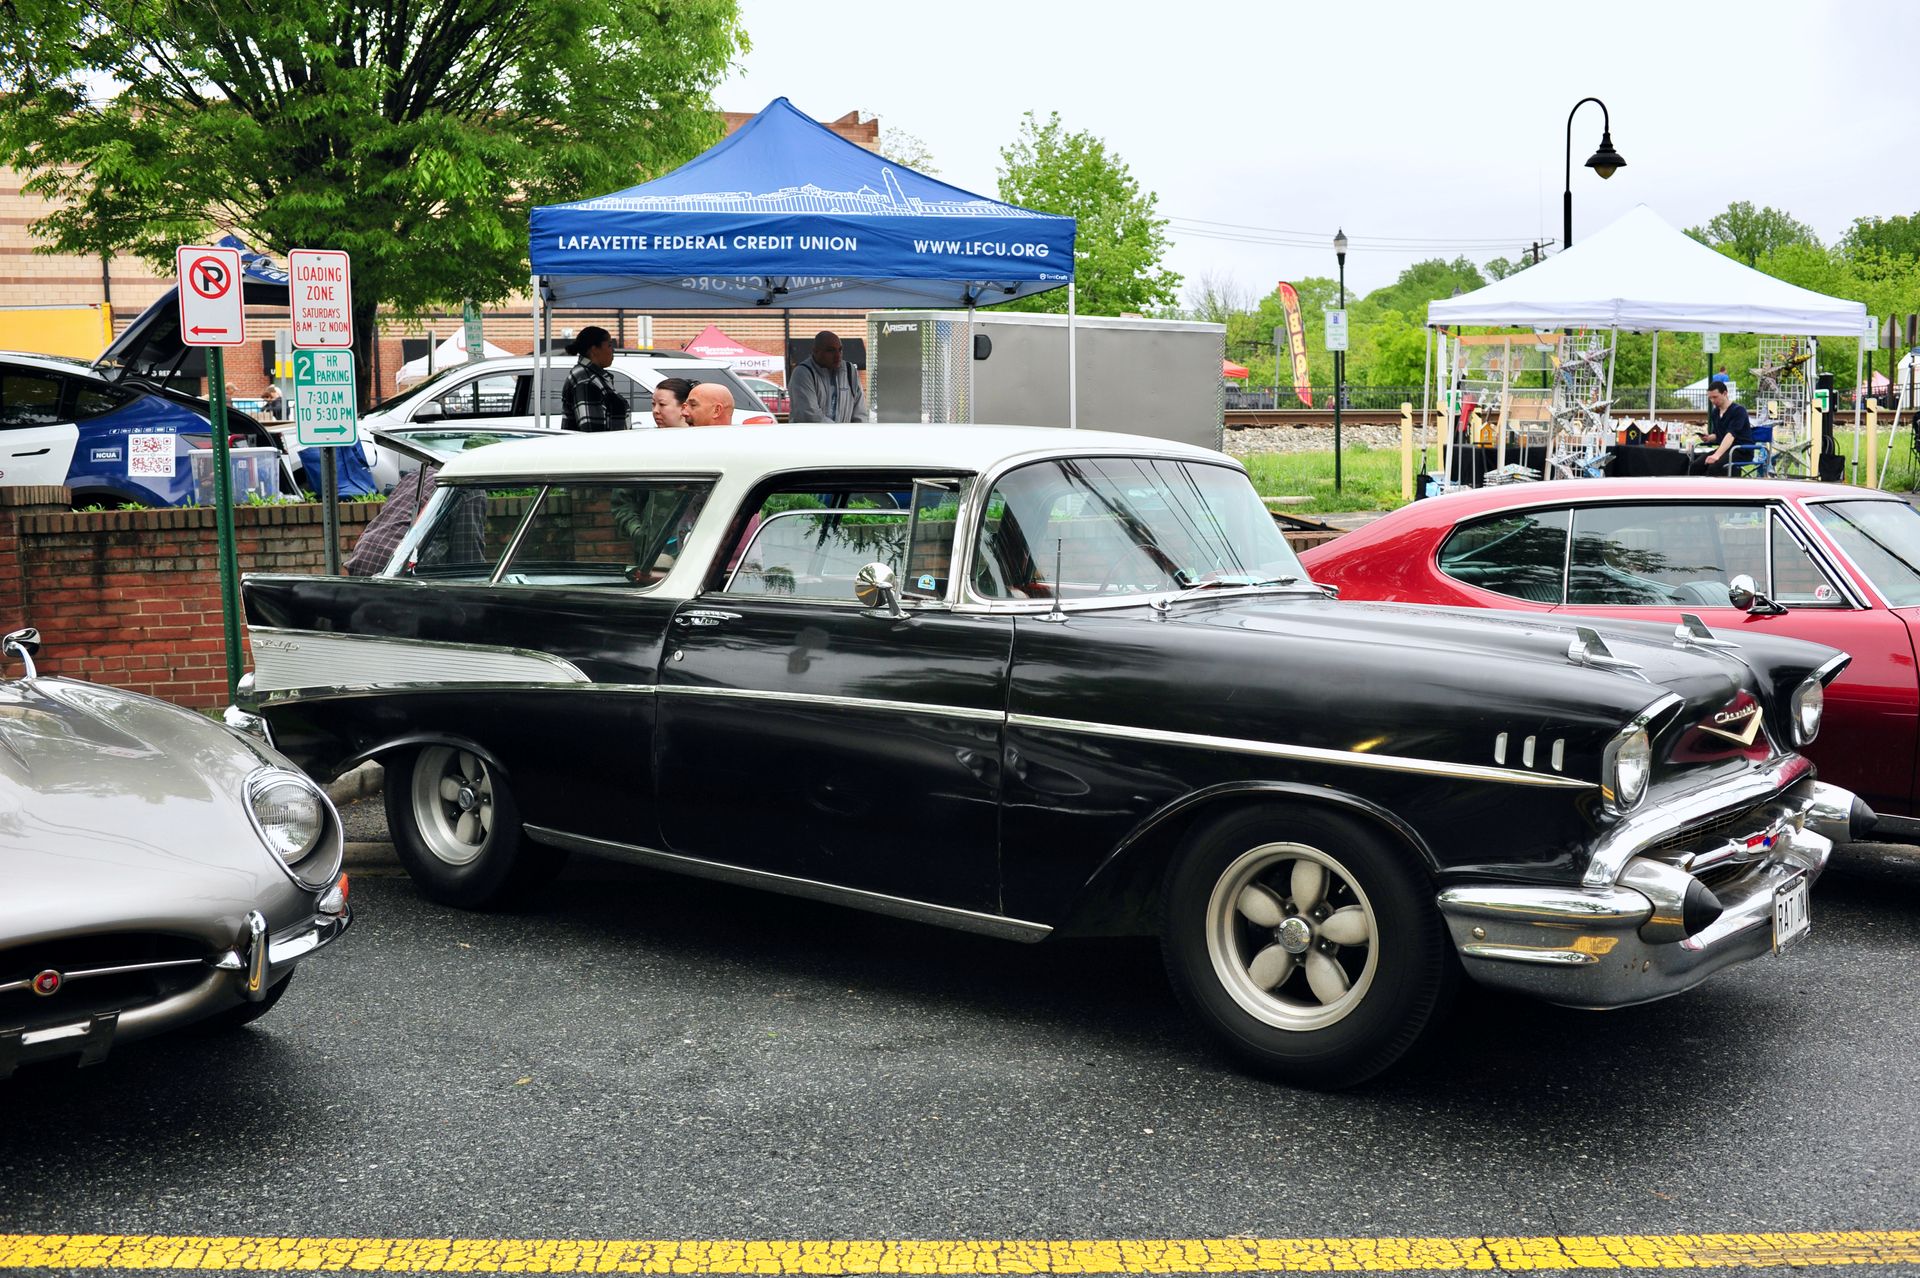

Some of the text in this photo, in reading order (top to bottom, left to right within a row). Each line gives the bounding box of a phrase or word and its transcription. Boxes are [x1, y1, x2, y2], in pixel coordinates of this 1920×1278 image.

[558, 235, 857, 251] LAFAYETTE FEDERAL CREDIT UNION
[913, 239, 1049, 257] WWW.LFCU.ORG
[297, 266, 342, 282] LOADING
[306, 285, 335, 301] ZONE
[302, 307, 341, 319] SATURDAYS
[296, 322, 301, 332] 8
[302, 322, 312, 332] AM
[319, 322, 326, 332] 12
[329, 321, 349, 332] NOON
[298, 355, 338, 380] 2 HR
[316, 370, 350, 382] PARKING
[307, 391, 344, 405] 7:30 AM
[300, 407, 353, 421] TO 5:30 PM
[1778, 897, 1793, 935] RAT
